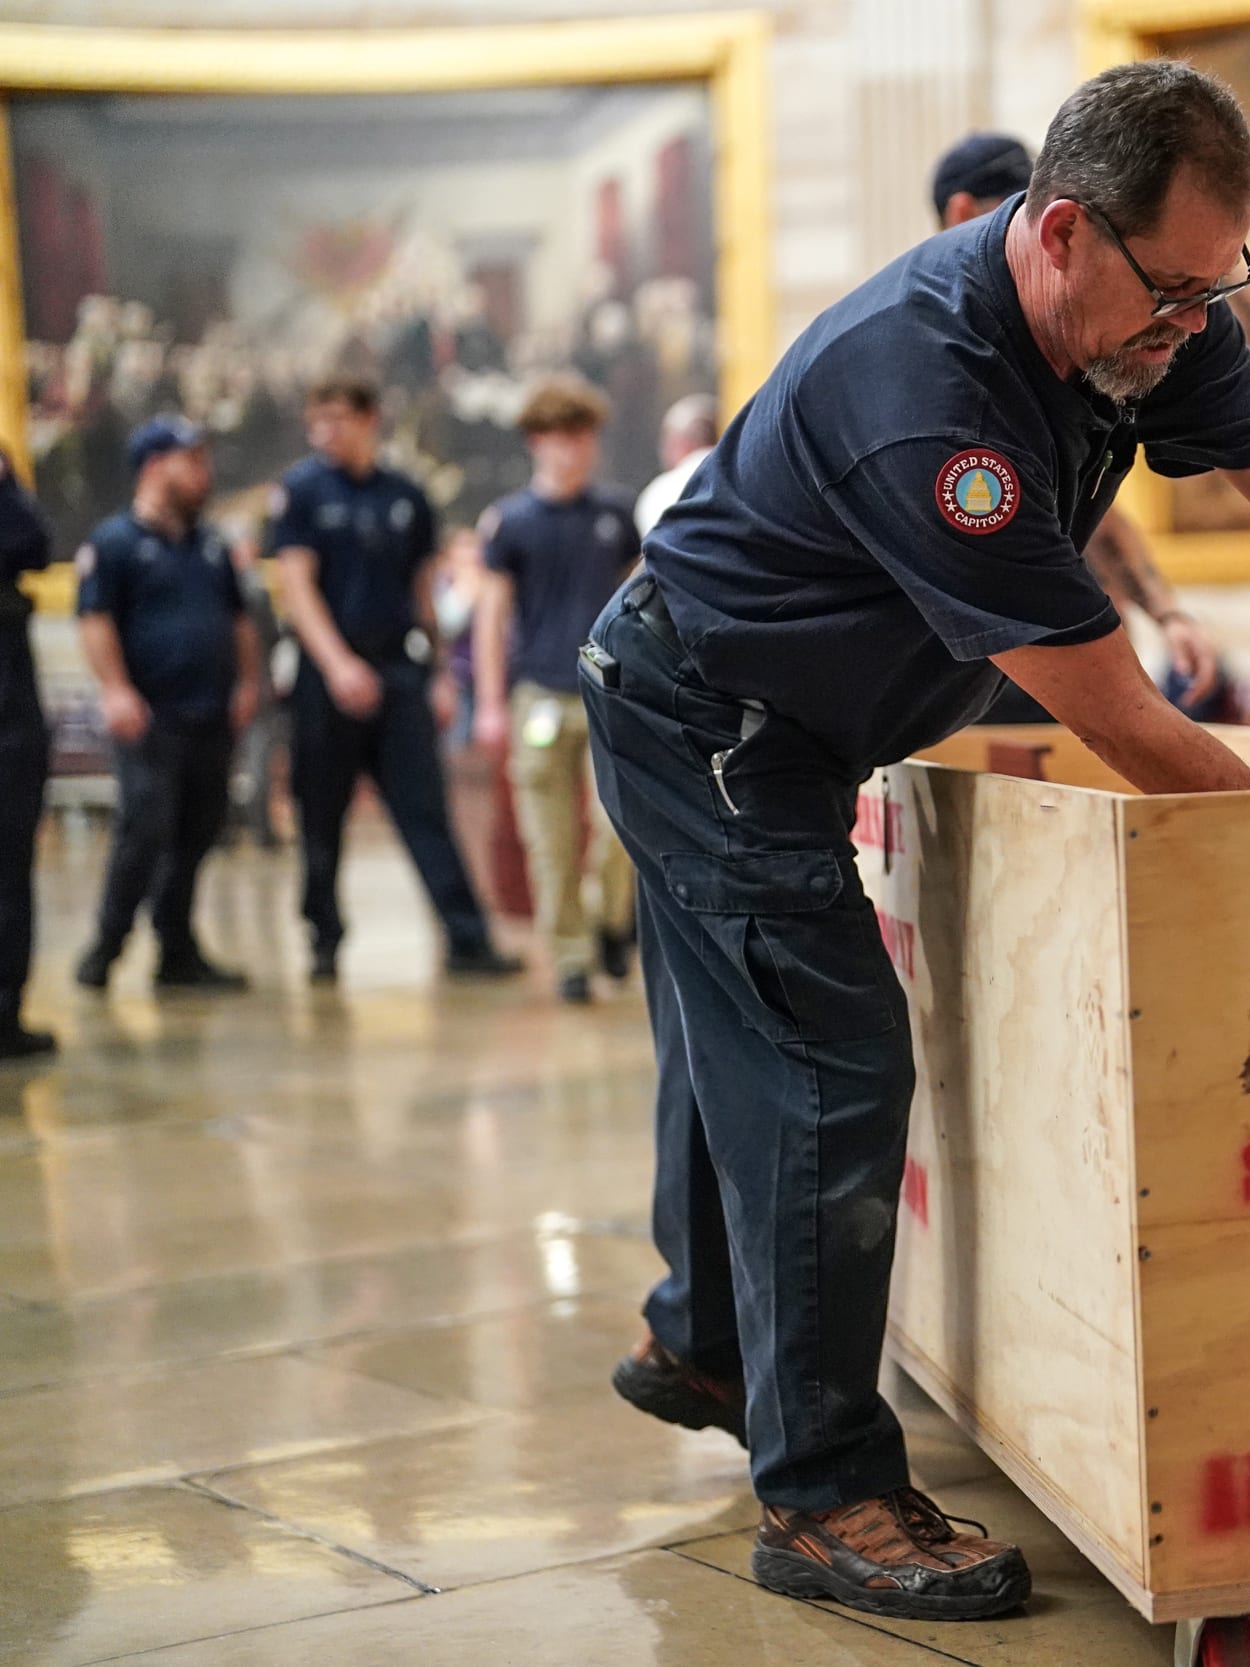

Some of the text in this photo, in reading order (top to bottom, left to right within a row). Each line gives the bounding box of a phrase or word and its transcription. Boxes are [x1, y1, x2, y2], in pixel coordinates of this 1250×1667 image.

[943, 456, 1014, 491] UNITED STATES
[955, 511, 1003, 528] CAPITOL
